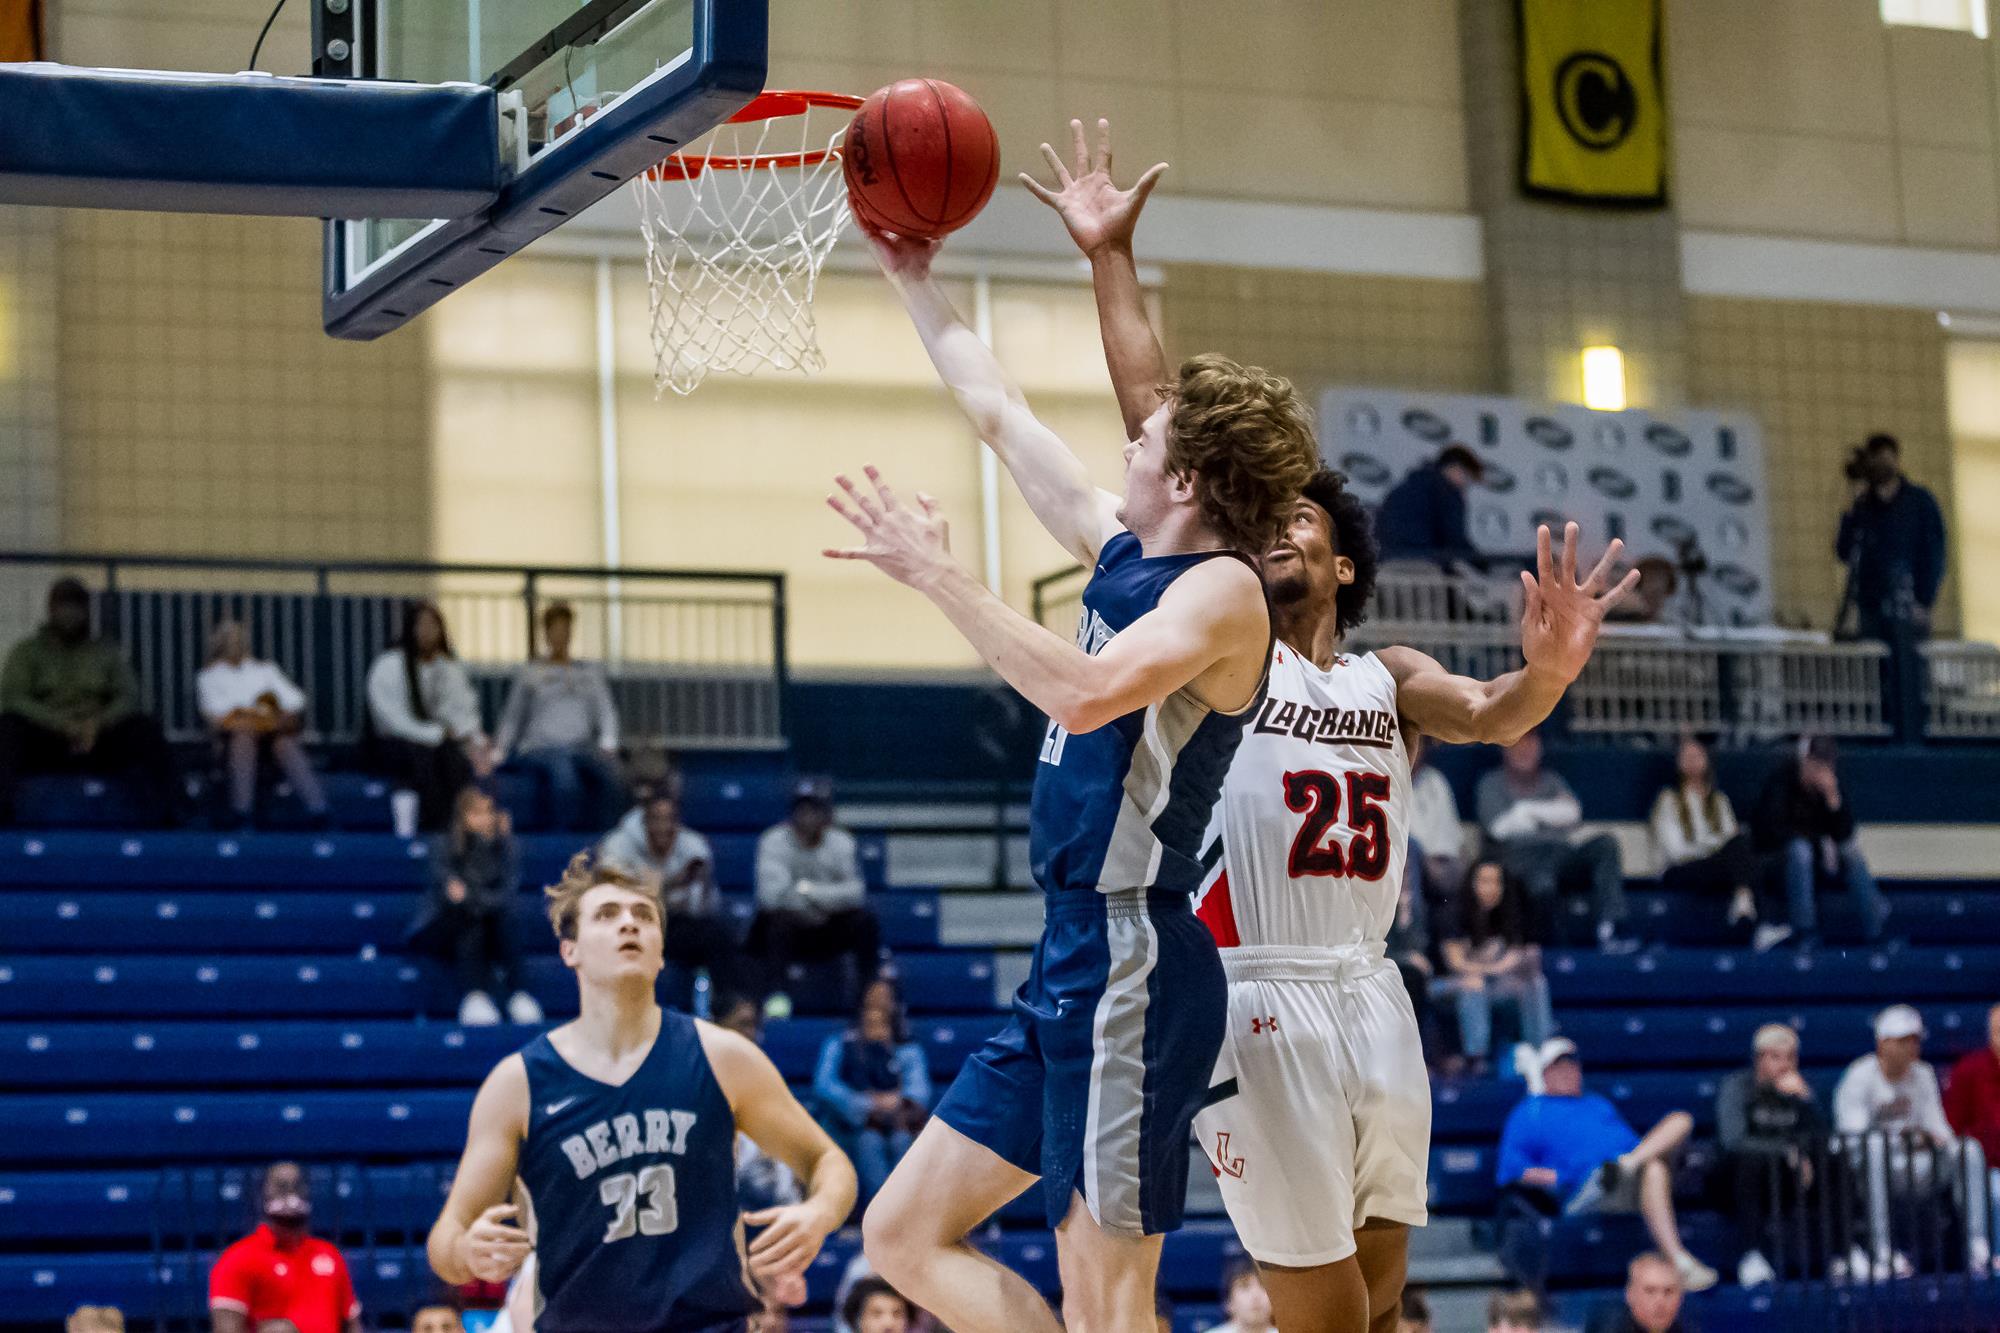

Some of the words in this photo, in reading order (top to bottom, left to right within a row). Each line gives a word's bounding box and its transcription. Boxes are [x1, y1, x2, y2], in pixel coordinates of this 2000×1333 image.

[1554, 51, 1638, 152] C
[1282, 769, 1391, 881] 25
[560, 1108, 697, 1180] BERRY
